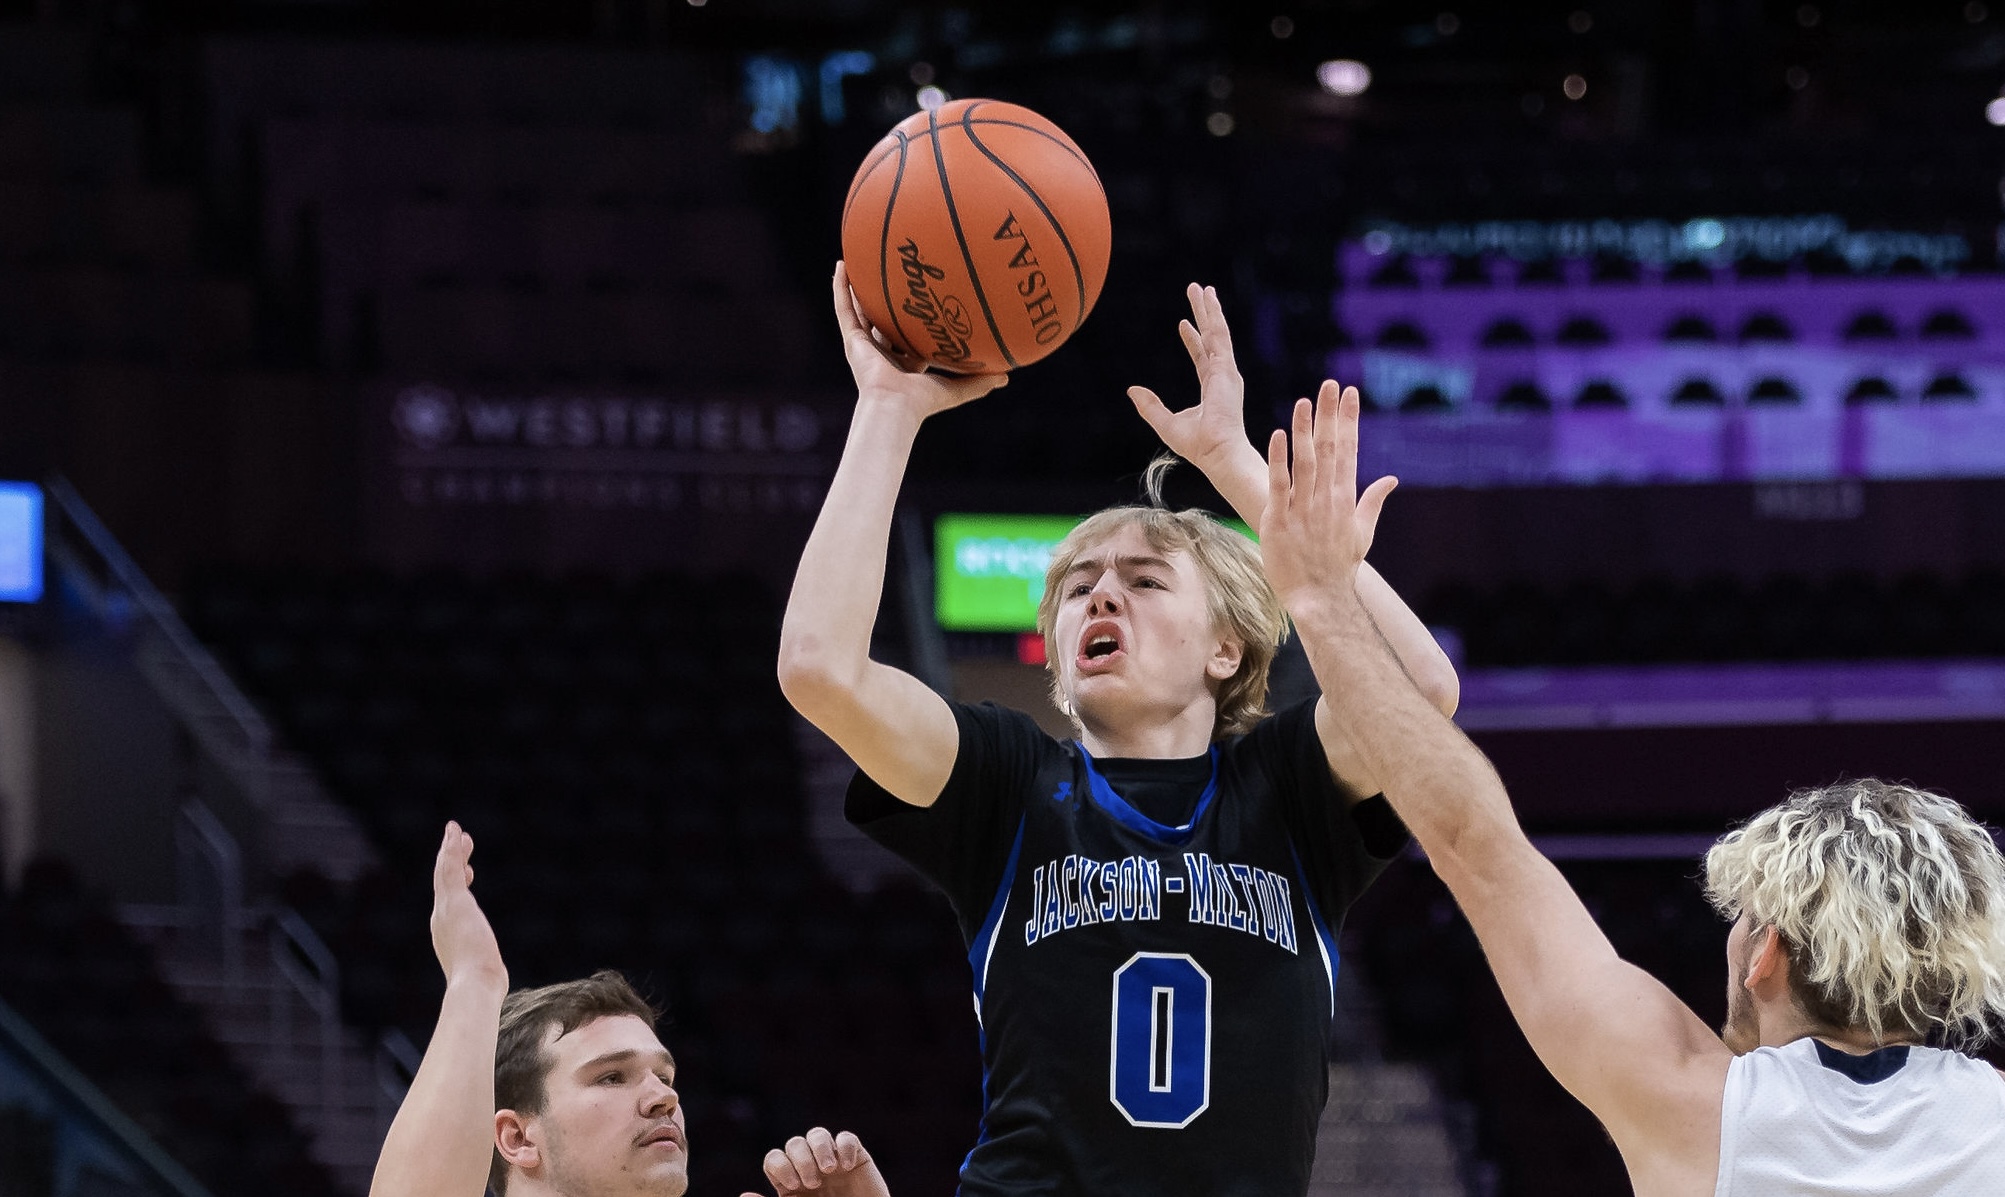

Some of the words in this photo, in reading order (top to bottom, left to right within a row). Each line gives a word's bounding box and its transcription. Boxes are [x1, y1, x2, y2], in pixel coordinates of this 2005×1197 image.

[993, 209, 1062, 345] OHSAA
[1025, 852, 1298, 955] JACKSON-MILTON
[1110, 951, 1212, 1129] 0
